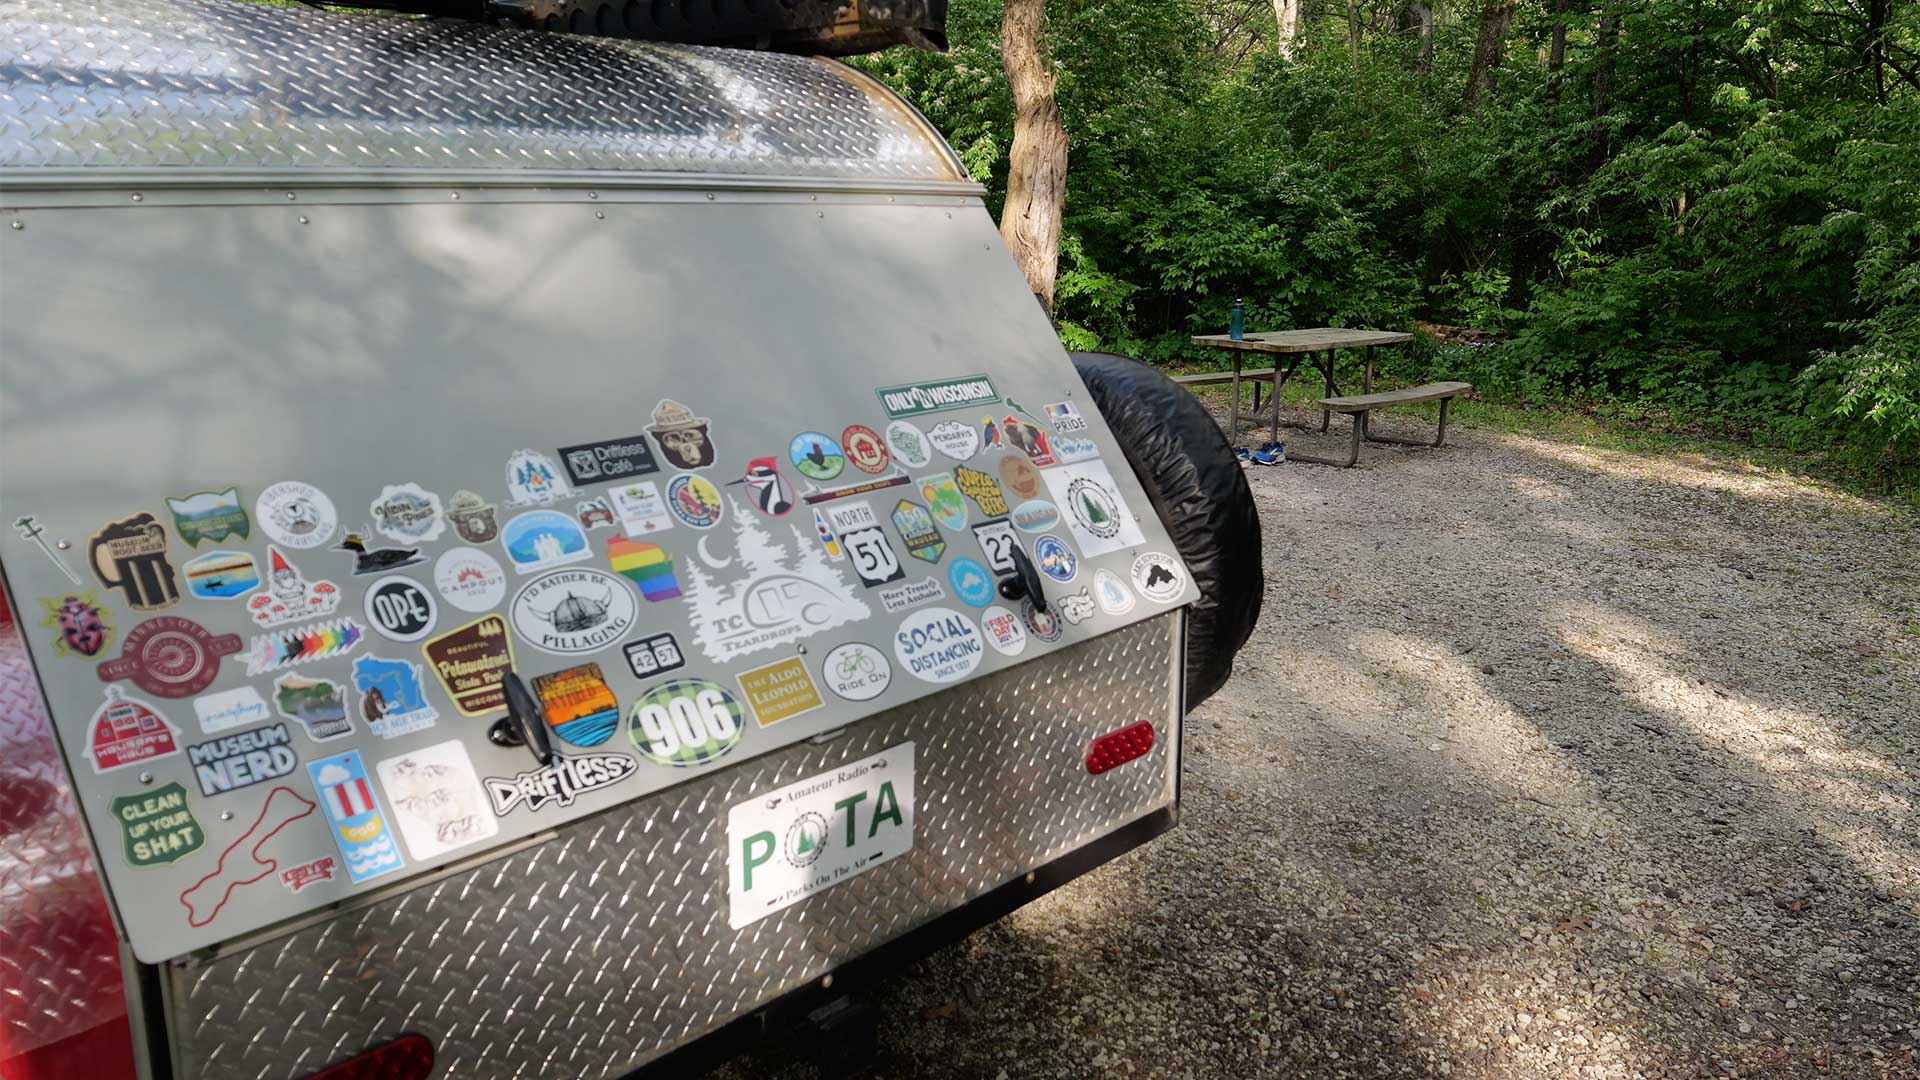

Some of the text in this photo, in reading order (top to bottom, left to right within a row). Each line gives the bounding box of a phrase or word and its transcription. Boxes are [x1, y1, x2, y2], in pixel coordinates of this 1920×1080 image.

[884, 391, 916, 412] ONLY
[928, 380, 994, 405] WISCONSIN
[1054, 419, 1086, 433] PRIDE
[595, 442, 645, 462] Driftless
[834, 506, 873, 528] NORTH
[855, 539, 891, 571] 51
[440, 576, 503, 594] CAMPOUT
[539, 572, 587, 593] RATHER
[590, 575, 607, 587] BE
[882, 583, 930, 602] More Trees
[374, 588, 428, 630] OPE
[886, 589, 942, 609] Less Assholes
[542, 616, 627, 648] PILLAGING
[712, 615, 743, 634] TC
[988, 613, 1015, 628] FIELD
[993, 625, 1012, 638] DAY
[723, 624, 801, 652] TEARDROPS
[898, 616, 972, 654] SOCIAL
[635, 653, 654, 669] 42
[658, 647, 675, 662] 57
[910, 638, 981, 673] DISTANCING
[768, 666, 801, 685] ALDO
[838, 677, 865, 694] RIDE
[464, 692, 504, 709] WISCONS
[753, 679, 808, 705] LEOPOLD
[639, 689, 736, 757] 906
[189, 724, 290, 765] MUSEUM
[195, 745, 296, 796] NERD
[785, 765, 869, 802] Amateur Radio
[122, 792, 181, 821] CLEAN
[129, 812, 190, 838] UP YOUR
[785, 856, 868, 900] Parks On The Air
